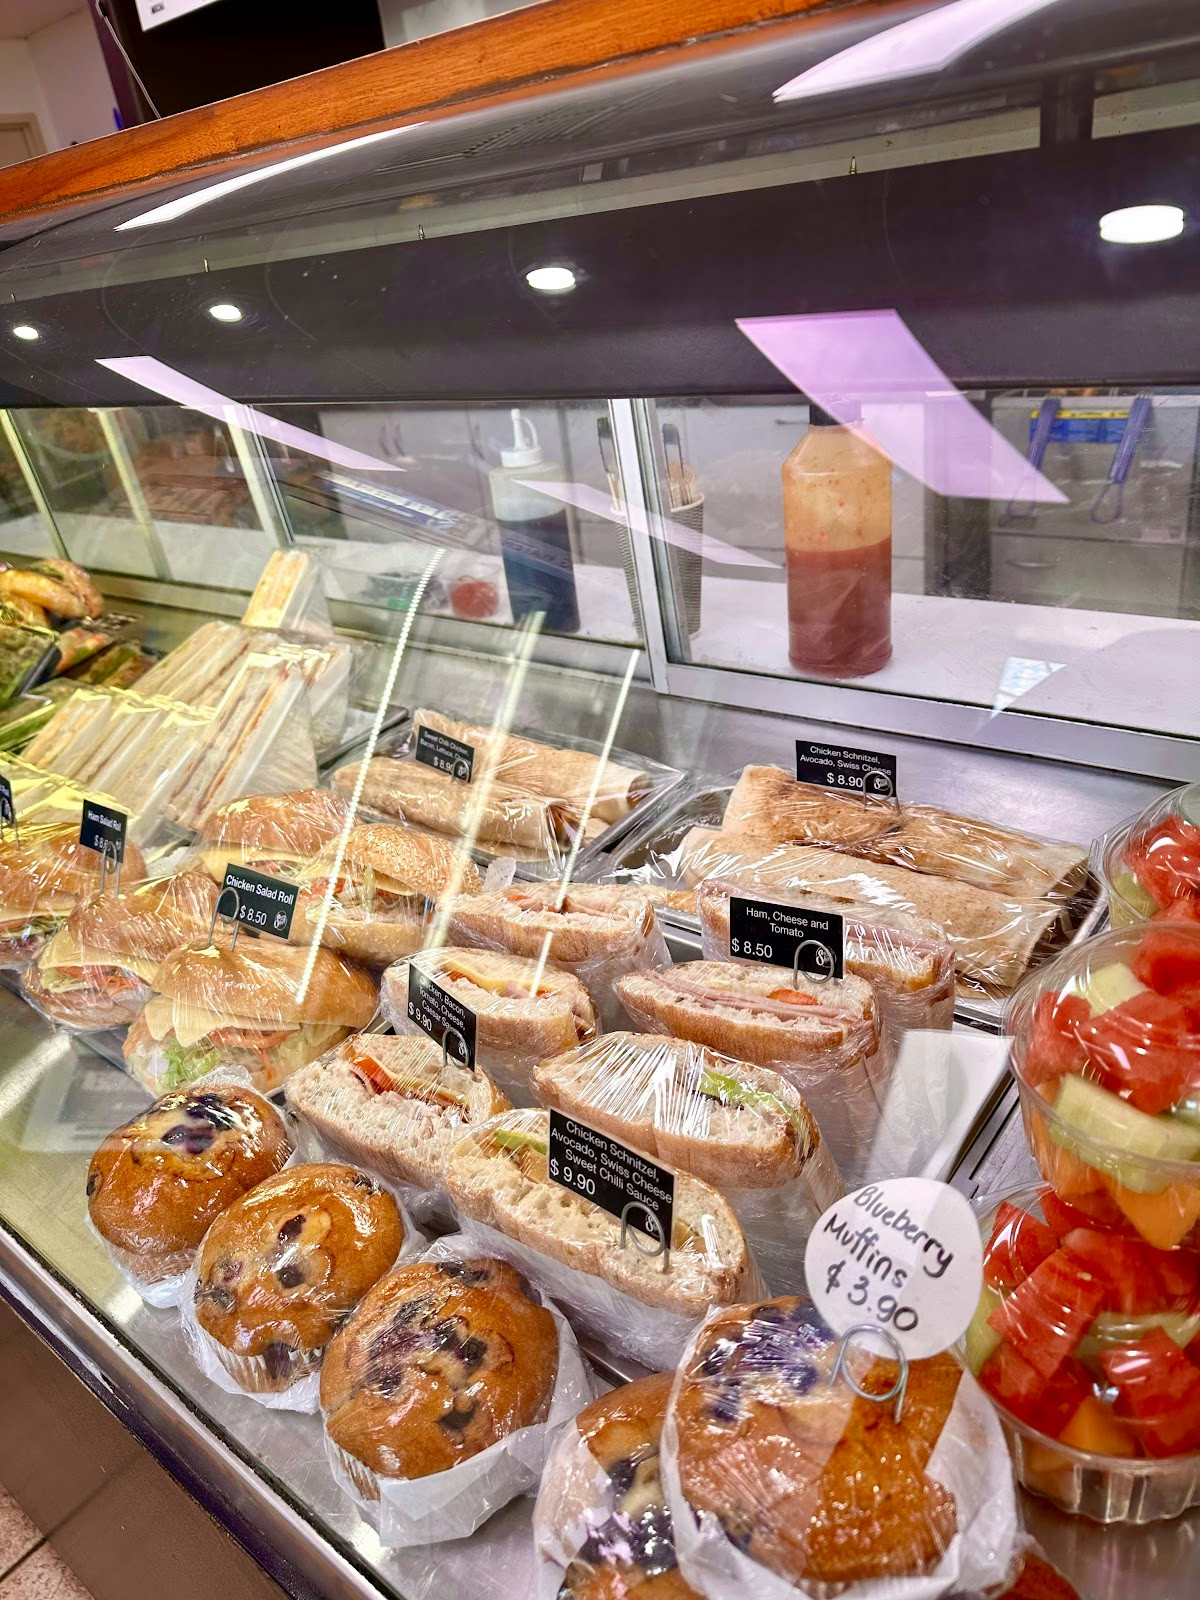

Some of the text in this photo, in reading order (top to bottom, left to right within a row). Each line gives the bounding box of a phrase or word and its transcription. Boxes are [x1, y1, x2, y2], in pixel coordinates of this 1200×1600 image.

[433, 756, 439, 767] $
[800, 754, 836, 768] Avocado,
[837, 759, 860, 771] Swiss
[810, 745, 881, 765] Chicken Schnitzel,
[826, 772, 835, 784] $
[837, 774, 863, 788] 8.90
[88, 810, 122, 832] Ham Salad Roll
[94, 834, 99, 847] $
[226, 874, 295, 906] Chicken Salad Roll
[240, 904, 247, 919] $
[247, 908, 267, 926] 8.50
[746, 907, 829, 931] Ham, Cheese and
[769, 923, 804, 938] Tomato
[731, 937, 773, 958] $ 8.50
[408, 1001, 415, 1016] $
[415, 1008, 432, 1032] 9.90
[419, 985, 441, 1011] Tomato,
[441, 1004, 466, 1031] Cheese,
[421, 1000, 441, 1022] Caesar
[444, 995, 466, 1020] Bacon,
[566, 1121, 660, 1183] Chicken Schnitzel,
[550, 1157, 596, 1195] $ 9.90
[551, 1127, 672, 1204] Avocado, Swiss Cheese
[566, 1149, 659, 1211] Sweet Chilli Sauce
[854, 1186, 954, 1278] Blueberry
[824, 1213, 907, 1288] Muffins
[826, 1260, 918, 1331] $ 3.90
